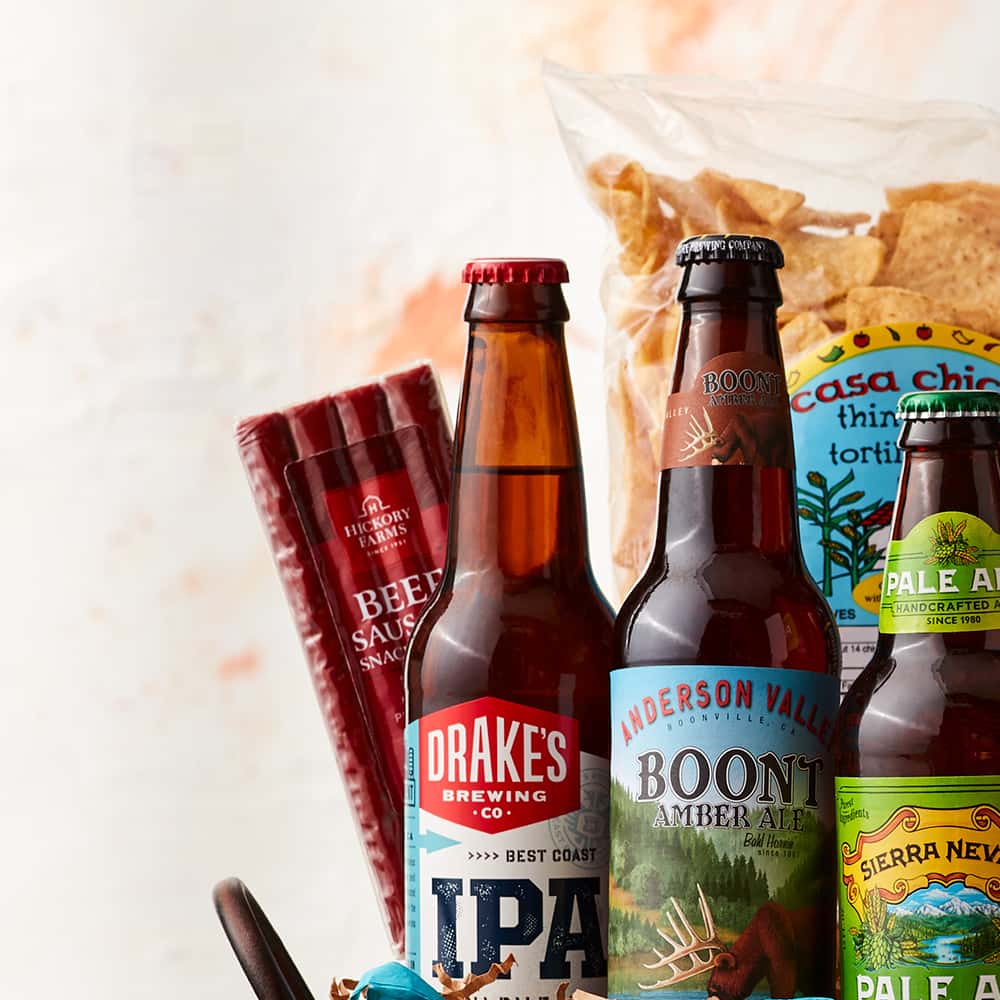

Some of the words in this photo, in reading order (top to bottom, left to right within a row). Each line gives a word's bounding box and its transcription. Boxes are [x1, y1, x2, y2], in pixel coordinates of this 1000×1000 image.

[703, 369, 781, 395] BOONT
[791, 370, 899, 413] casa
[838, 404, 900, 430] thin
[829, 443, 901, 465] tortil
[344, 507, 411, 538] HICKORY
[358, 522, 408, 548] FARMS
[886, 569, 959, 596] PALE
[896, 601, 990, 613] HANDCRAFTED
[352, 613, 415, 652] SAUS
[926, 616, 957, 625] SINCE
[960, 616, 981, 624] 1980
[360, 646, 407, 672] SNAC
[620, 679, 752, 746] ANDERSON
[767, 682, 833, 747] VALLE
[427, 716, 567, 783] DRAKE'S
[637, 745, 824, 809] BOONT
[442, 790, 547, 802] BREWING
[481, 807, 503, 819] CO
[653, 803, 752, 829] AMBER
[758, 806, 805, 833] ALE
[506, 849, 547, 862] BEST
[552, 848, 597, 862] COAST
[860, 841, 940, 881] SIERRA
[431, 877, 609, 980] IPA
